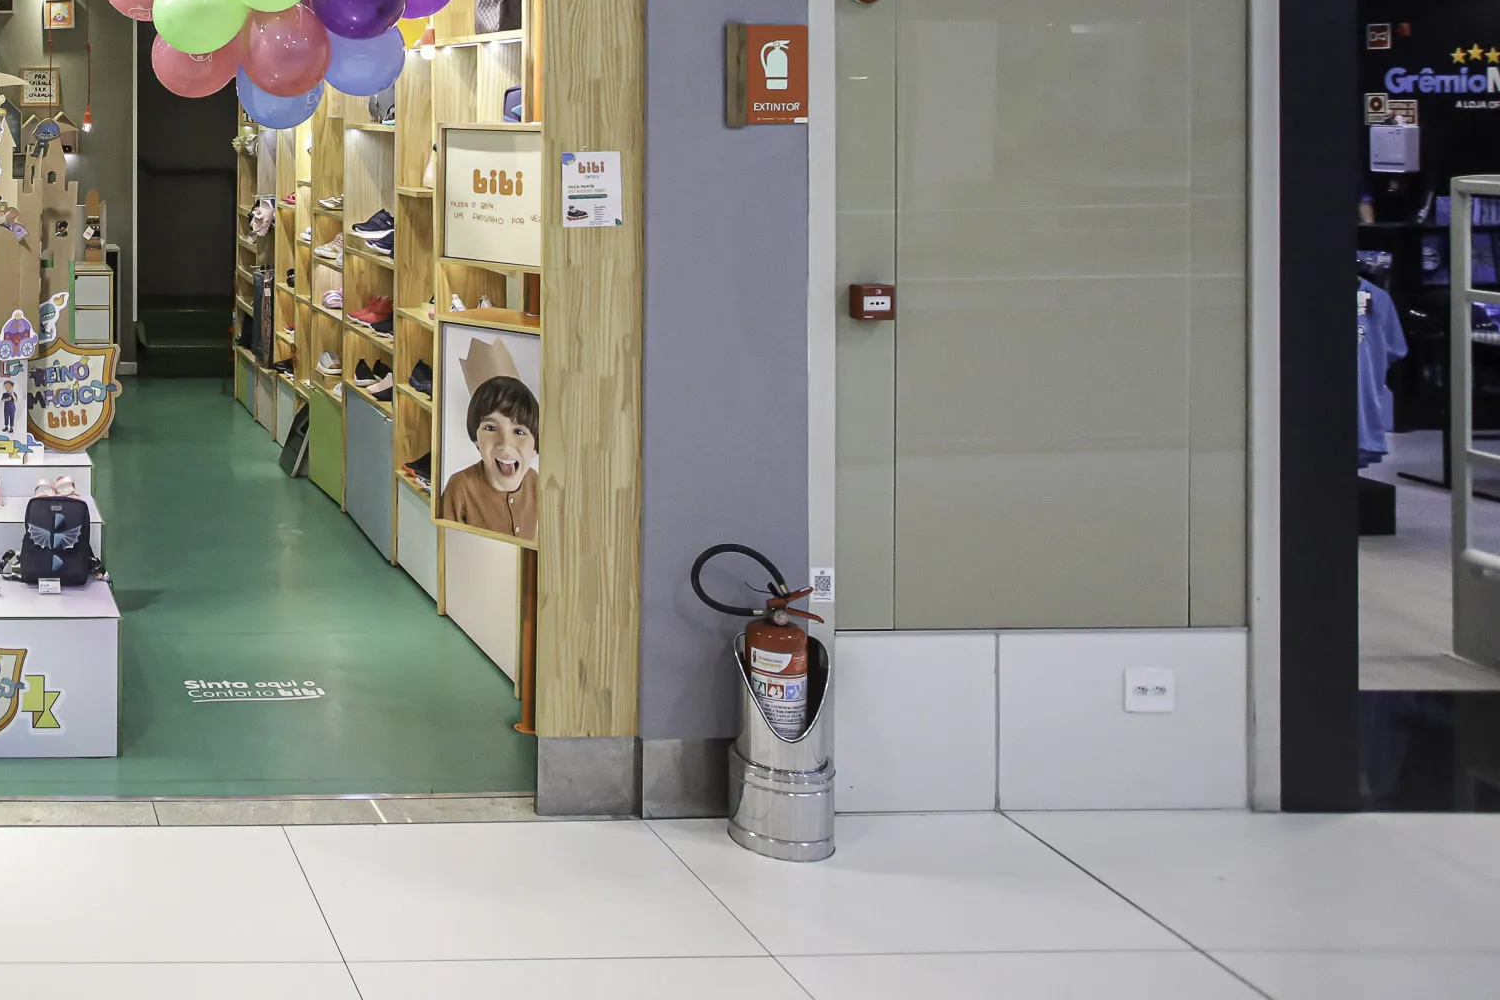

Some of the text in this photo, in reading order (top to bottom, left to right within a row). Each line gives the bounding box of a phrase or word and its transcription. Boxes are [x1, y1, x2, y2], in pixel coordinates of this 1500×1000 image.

[753, 102, 800, 112] EXTINTOR
[1463, 100, 1487, 109] LOJA
[577, 161, 605, 174] bibi
[473, 168, 524, 196] bibi
[450, 201, 469, 209] FAZER
[472, 213, 504, 225] PASSINHO
[511, 217, 525, 225] POR
[29, 355, 90, 387] REINO
[48, 408, 88, 428] bibi
[184, 680, 249, 690] Sinta
[254, 680, 298, 690] aqui
[187, 688, 326, 699] Conforto bibi
